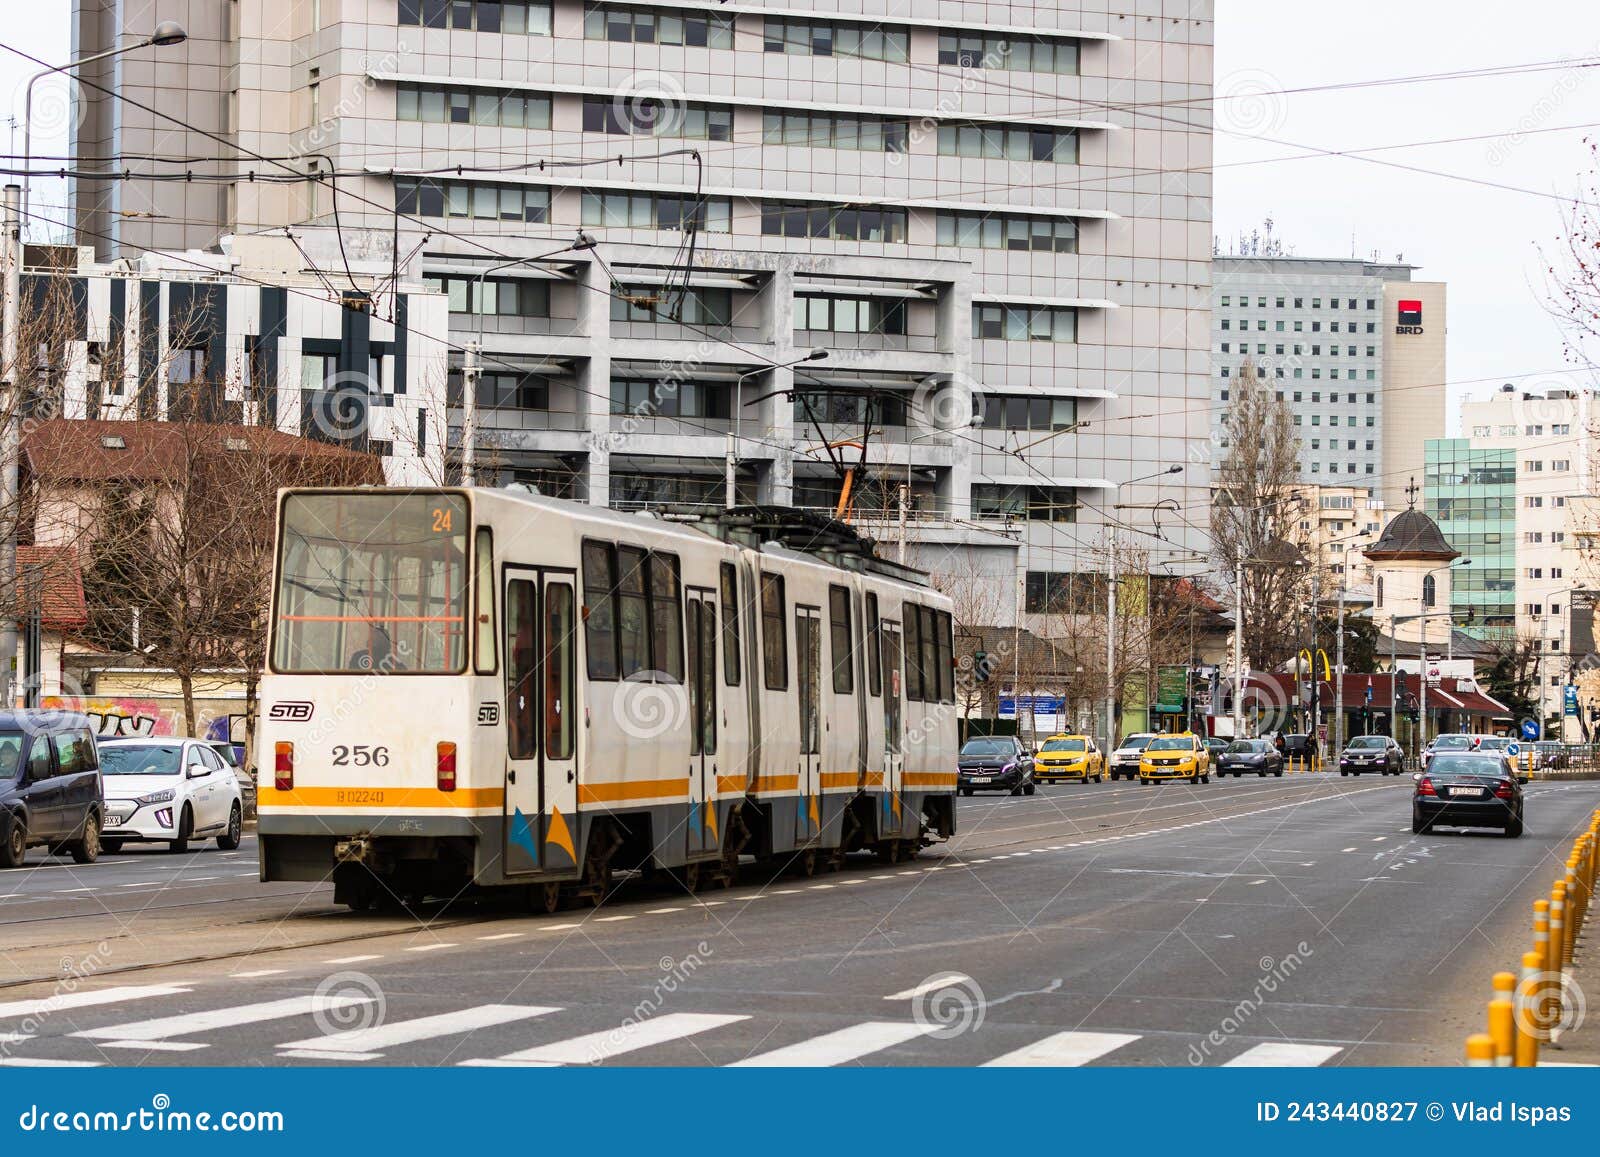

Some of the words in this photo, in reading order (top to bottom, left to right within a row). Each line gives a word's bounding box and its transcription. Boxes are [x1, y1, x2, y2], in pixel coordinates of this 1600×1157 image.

[1396, 326, 1424, 335] BRD
[432, 508, 452, 532] 24
[268, 703, 312, 719] STB
[477, 704, 499, 723] STB
[332, 745, 390, 767] 256
[347, 791, 384, 803] 02240
